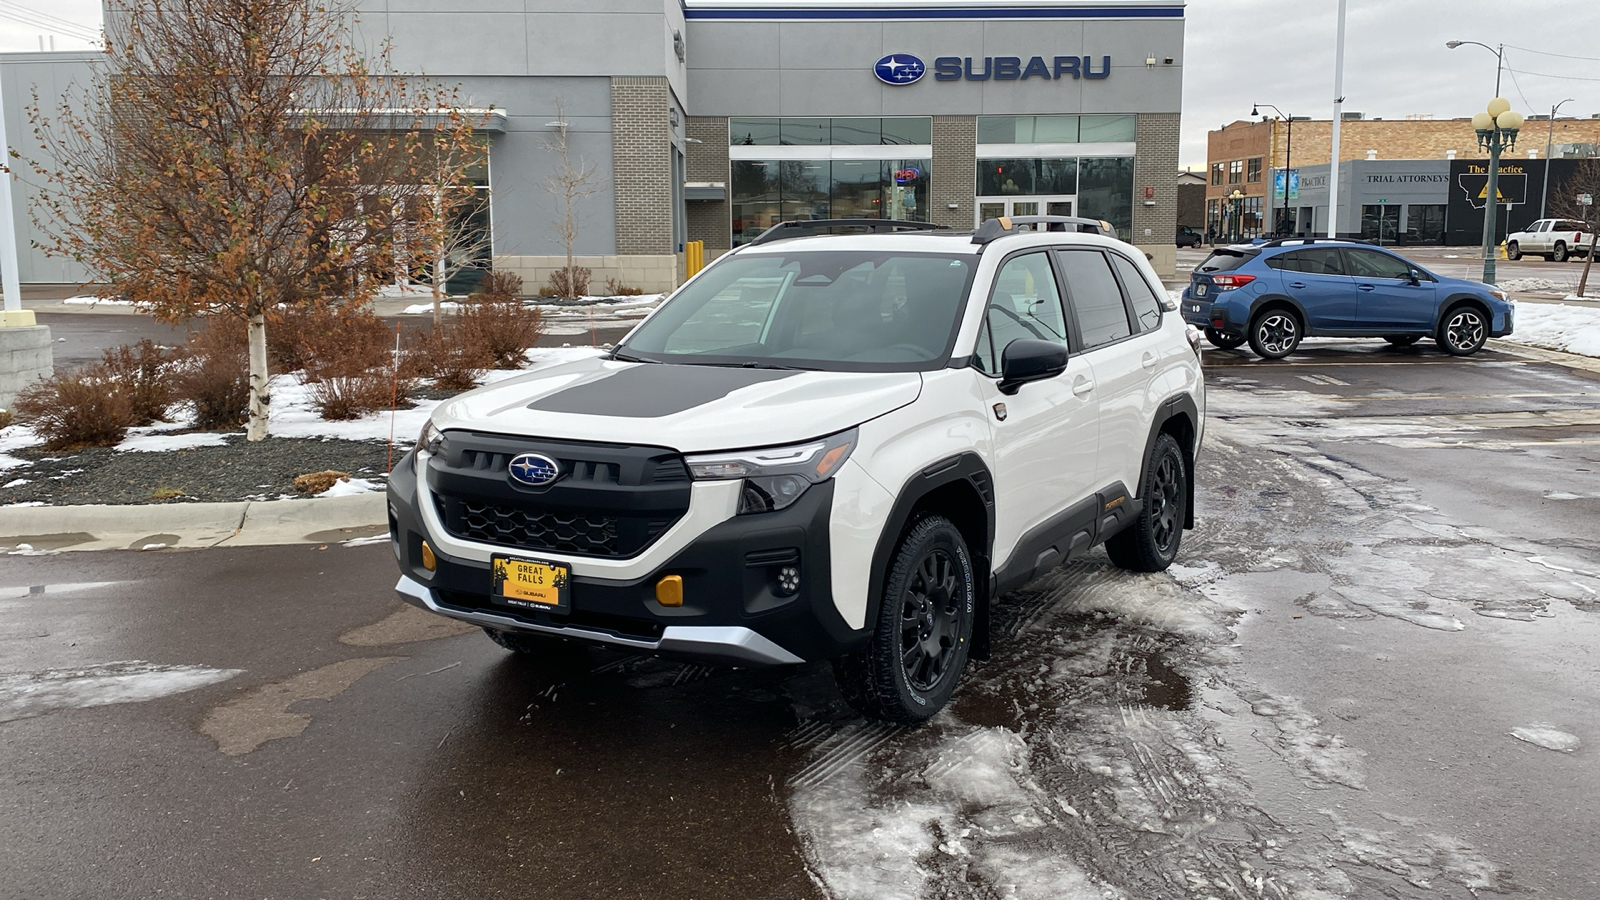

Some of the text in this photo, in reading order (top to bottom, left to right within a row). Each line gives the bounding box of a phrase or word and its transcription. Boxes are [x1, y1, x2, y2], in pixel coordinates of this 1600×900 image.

[934, 55, 1111, 81] SUBARU
[894, 169, 917, 179] OPEN
[1467, 164, 1523, 174] The actice
[1301, 176, 1326, 187] PRACTICE
[1367, 174, 1450, 183] TRIAL ATTORNEYS
[517, 564, 543, 575] GREAT
[517, 573, 544, 584] FALLS
[523, 590, 546, 598] SUBARU
